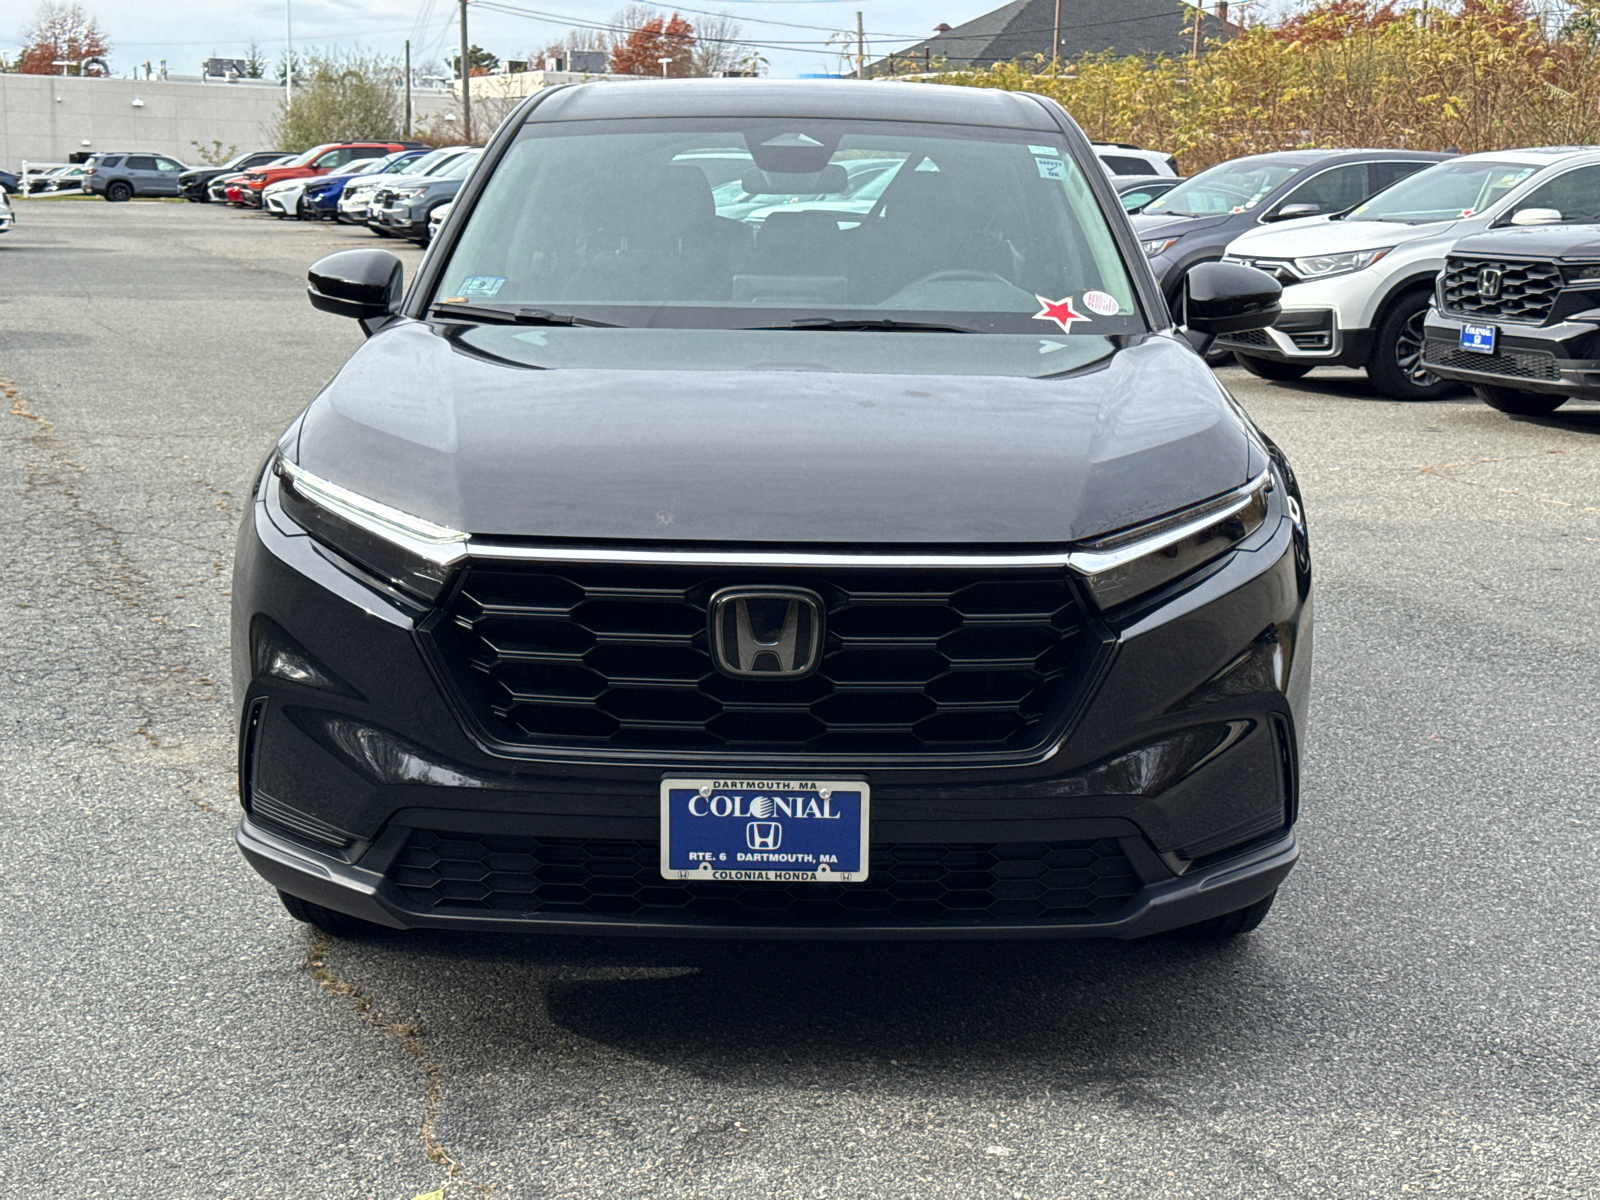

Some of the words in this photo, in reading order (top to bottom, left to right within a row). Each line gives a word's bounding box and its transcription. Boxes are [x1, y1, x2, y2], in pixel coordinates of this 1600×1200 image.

[799, 782, 817, 790] MA
[688, 795, 840, 819] COLONIAL
[689, 852, 716, 861] RTE.
[719, 852, 727, 861] 6
[736, 853, 816, 864] DARTMOUTH,
[819, 854, 838, 863] MA
[712, 871, 771, 880] COLONIAL
[774, 872, 817, 880] HONDA
